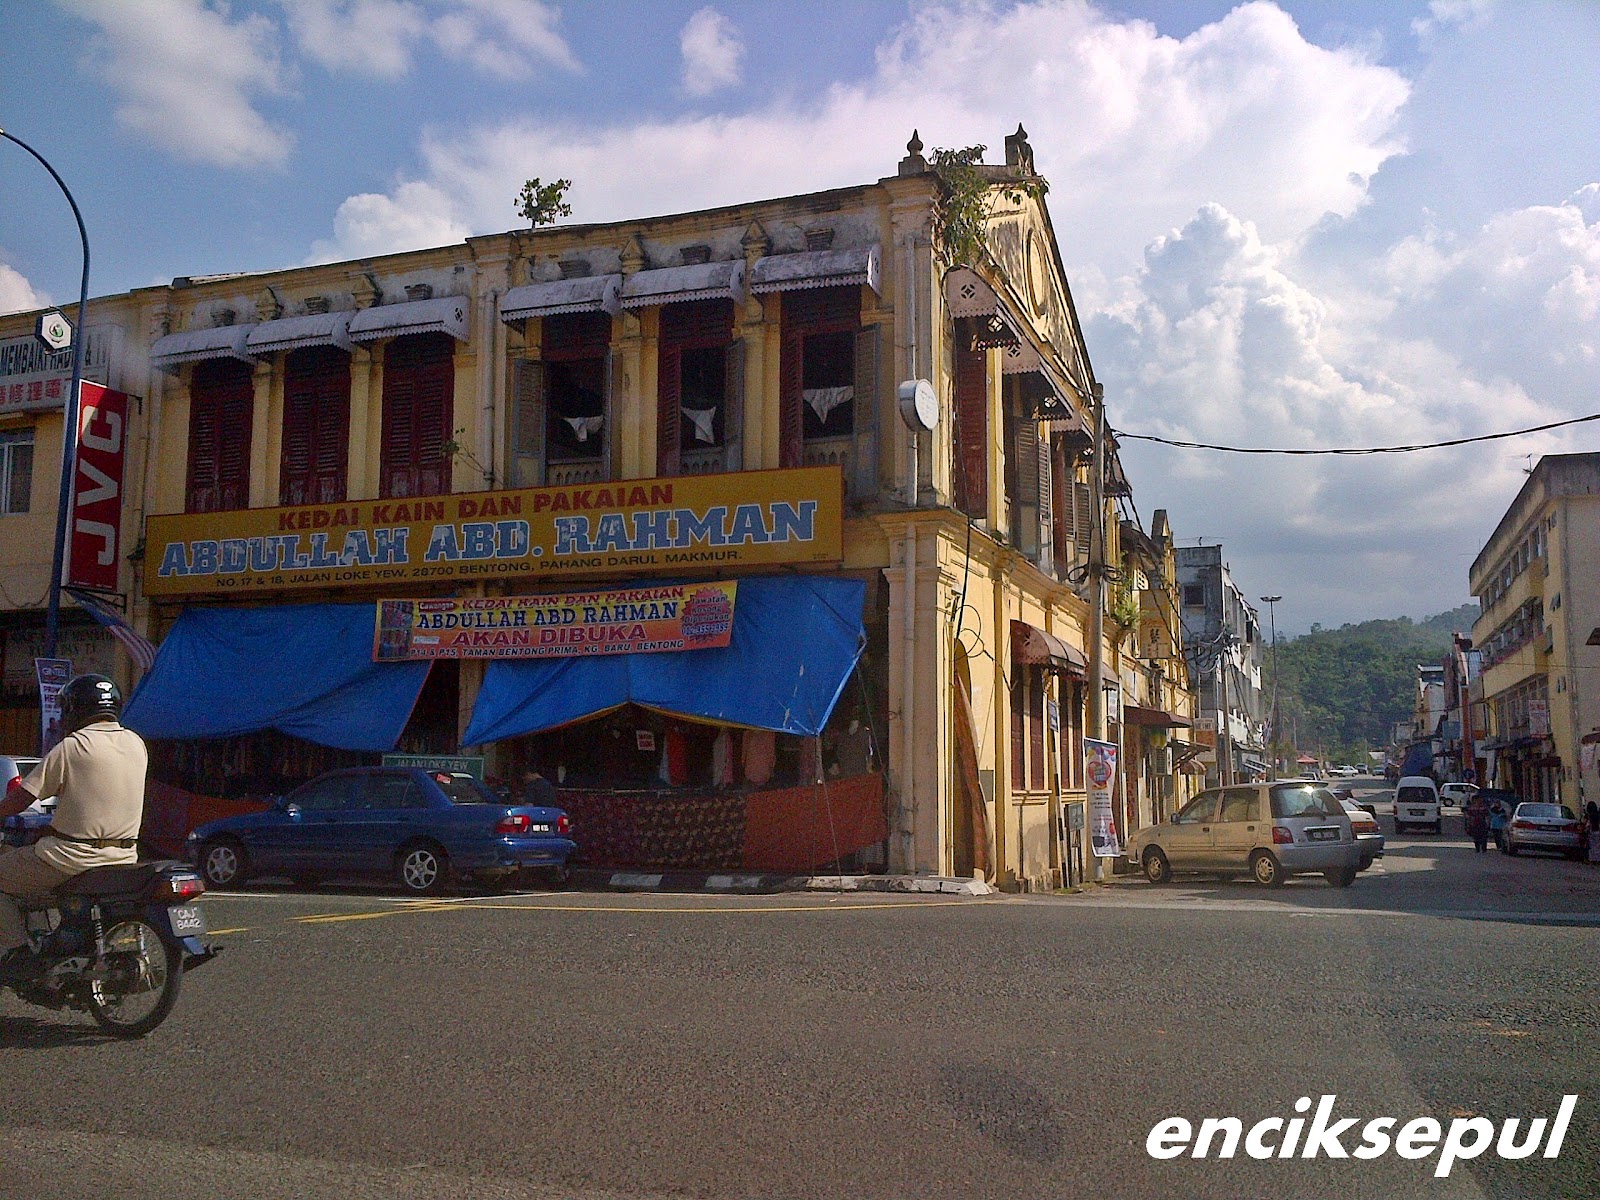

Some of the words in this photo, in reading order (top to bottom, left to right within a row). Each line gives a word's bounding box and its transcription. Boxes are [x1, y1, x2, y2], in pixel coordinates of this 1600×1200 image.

[75, 403, 122, 566] JVC
[278, 508, 360, 531] KEDAI
[372, 501, 445, 524] KAIN
[458, 496, 521, 518] DAN
[533, 484, 674, 513] PAKAIAN
[158, 527, 410, 577] ABDULLAH
[424, 519, 543, 563] ABD.
[553, 501, 818, 556] RAHMAN
[256, 577, 265, 586] &
[290, 572, 331, 584] JALAN
[335, 570, 371, 581] LOKE
[374, 568, 407, 579] YEW,
[412, 566, 454, 577] 28700
[459, 560, 535, 575] BENTONG,
[539, 557, 603, 570] PAHANG
[607, 555, 659, 567] DARUL
[665, 551, 743, 563] MAKMUR.
[462, 599, 513, 610] KEDAI
[517, 597, 559, 609] KAIN
[565, 595, 599, 606] DAN
[605, 587, 685, 604] PAKAIAN
[417, 611, 527, 629] ABDULLAH
[534, 607, 576, 626] ABD
[583, 602, 678, 624] RAHMAN
[452, 629, 530, 647] AKAN
[539, 624, 647, 645] DIBUKA
[462, 648, 496, 656] TAMAN
[498, 647, 546, 656] BENTONG
[636, 640, 684, 651] BENTONG
[395, 759, 423, 768] JALAN
[447, 761, 469, 770] YEW
